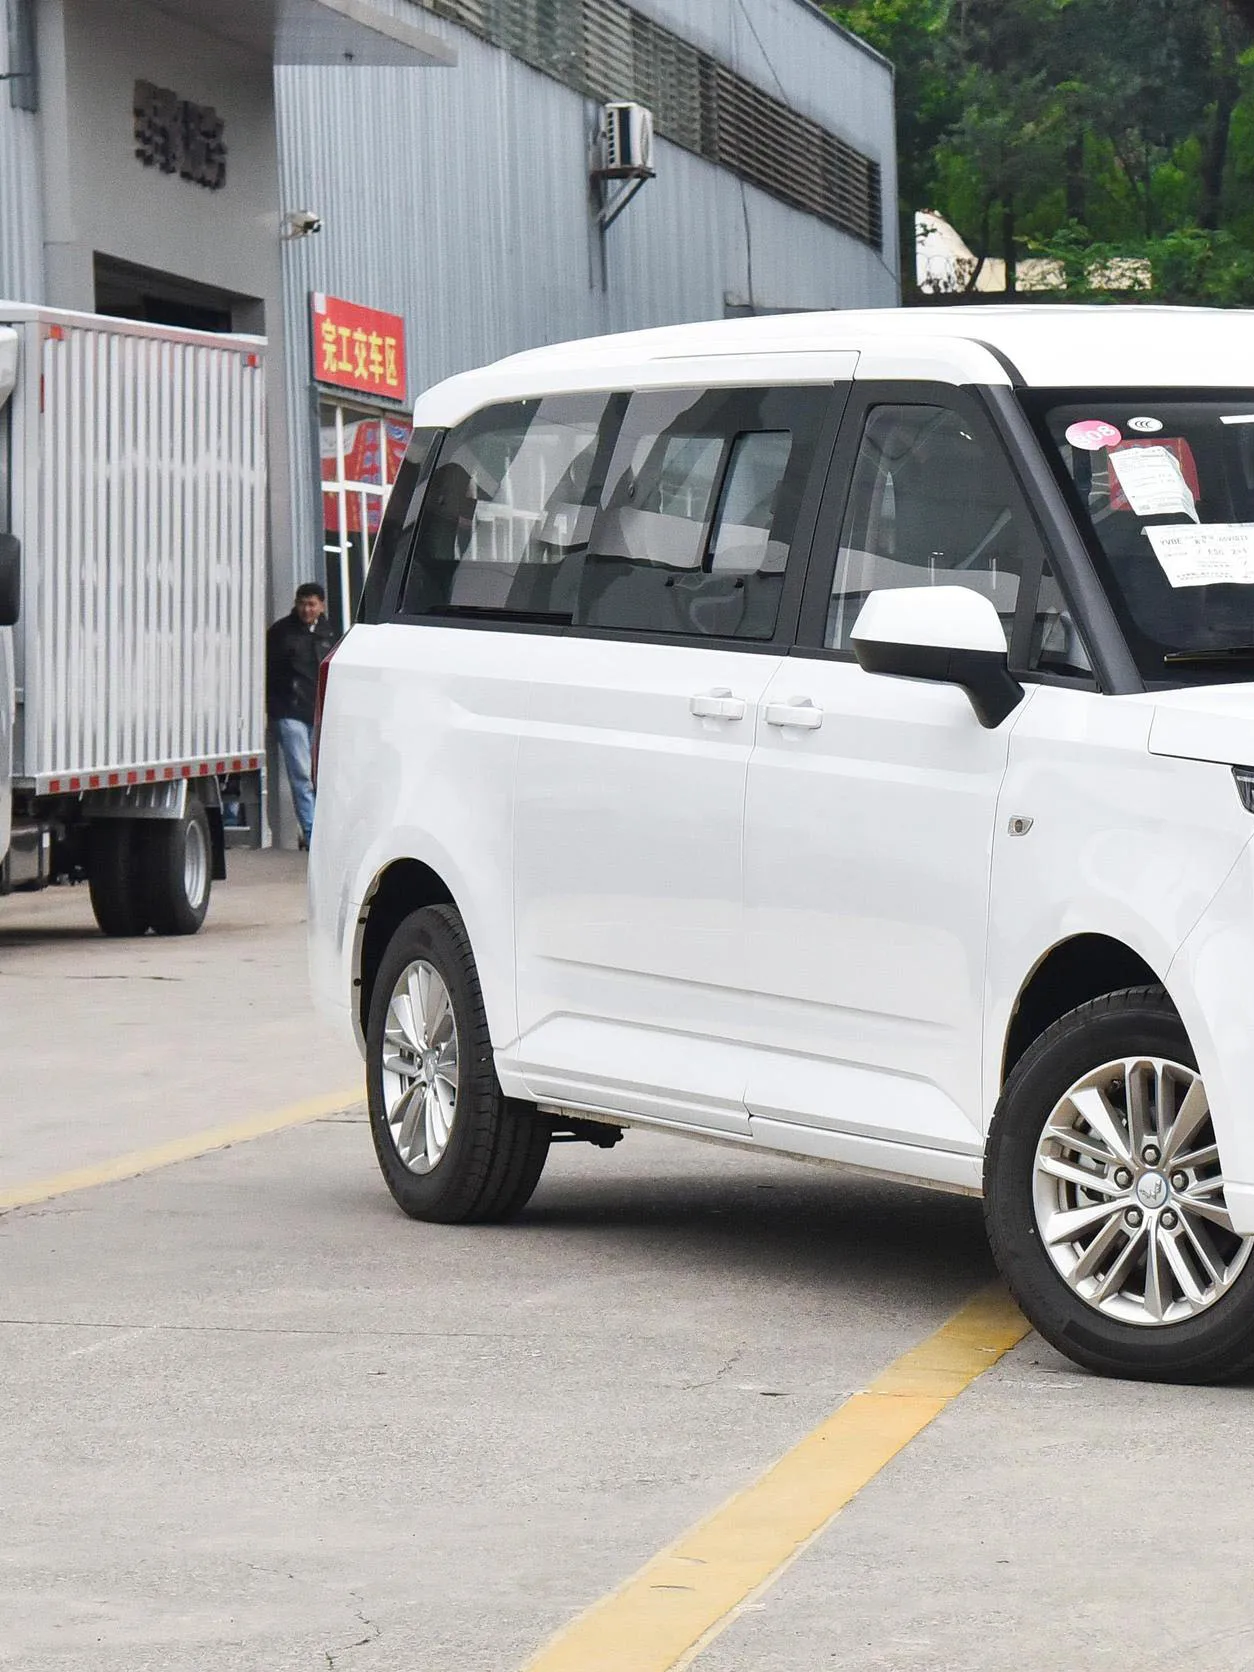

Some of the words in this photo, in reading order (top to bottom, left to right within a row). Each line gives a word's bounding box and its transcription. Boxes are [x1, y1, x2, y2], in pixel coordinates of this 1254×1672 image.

[321, 317, 398, 386] 完工交车区
